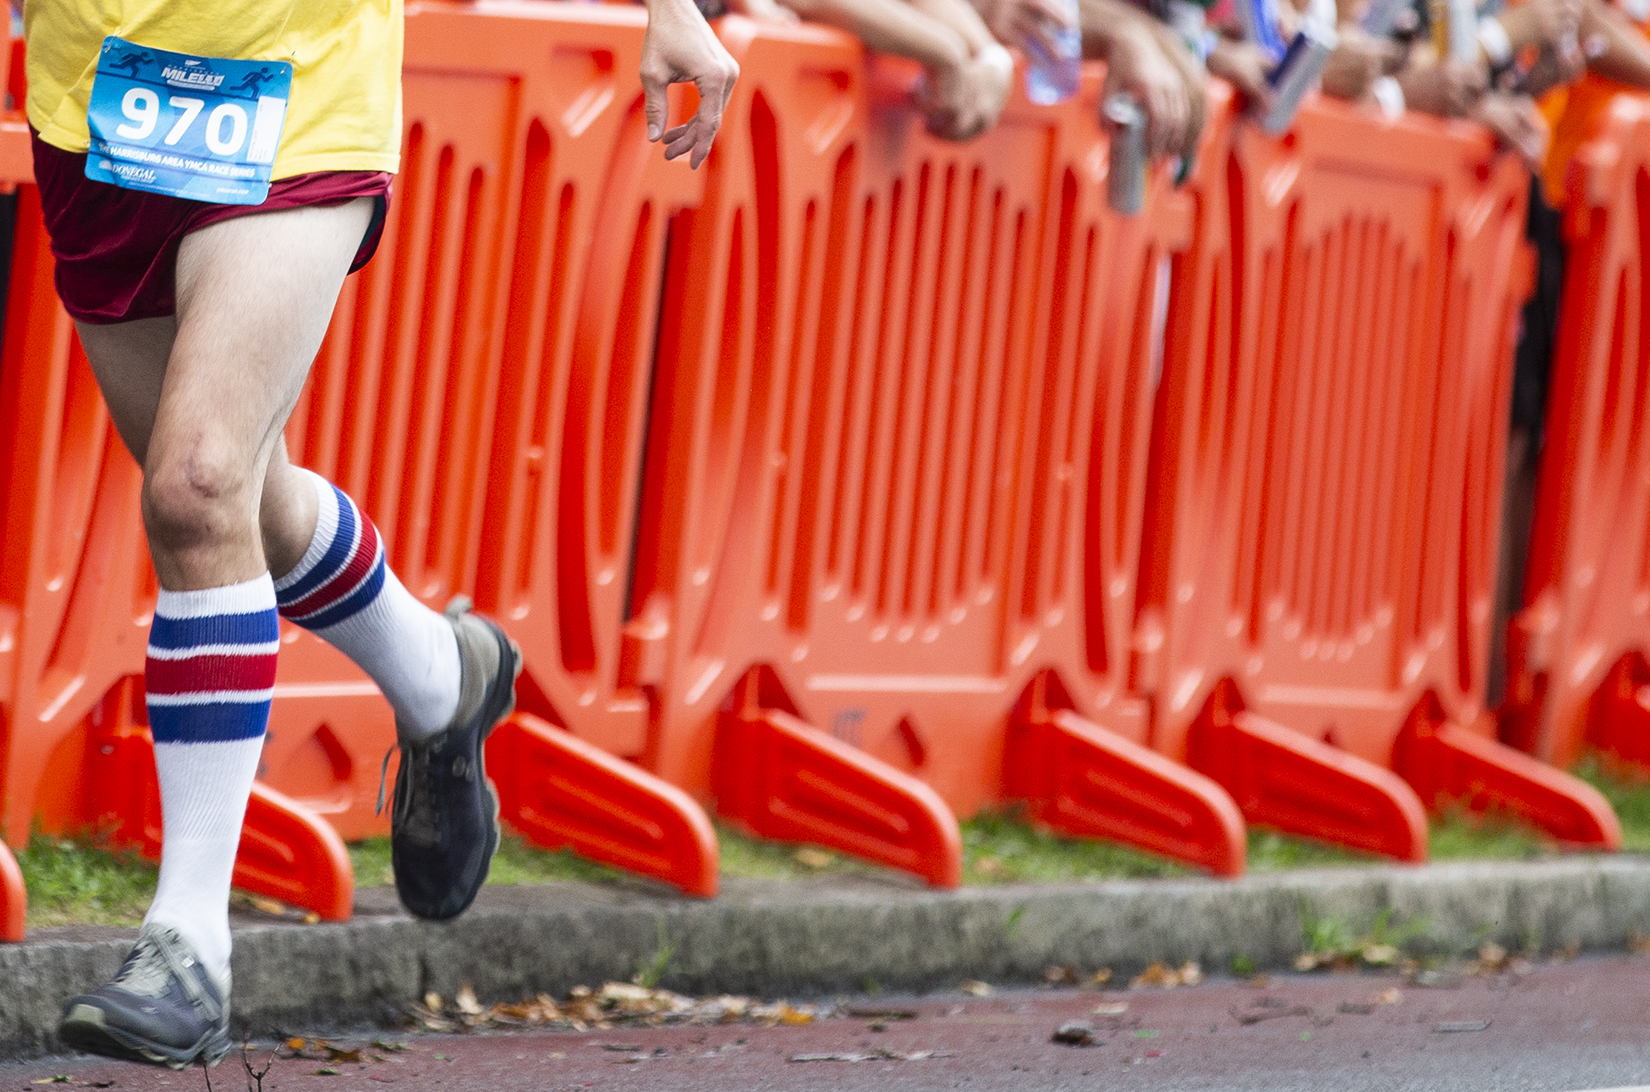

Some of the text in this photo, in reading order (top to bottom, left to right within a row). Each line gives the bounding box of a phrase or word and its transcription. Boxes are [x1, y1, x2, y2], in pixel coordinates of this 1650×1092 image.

[115, 87, 248, 156] 970
[110, 146, 162, 164] HARRISBURG
[161, 155, 184, 168] AREA
[184, 160, 208, 172] YMCA
[208, 164, 230, 176] RACE
